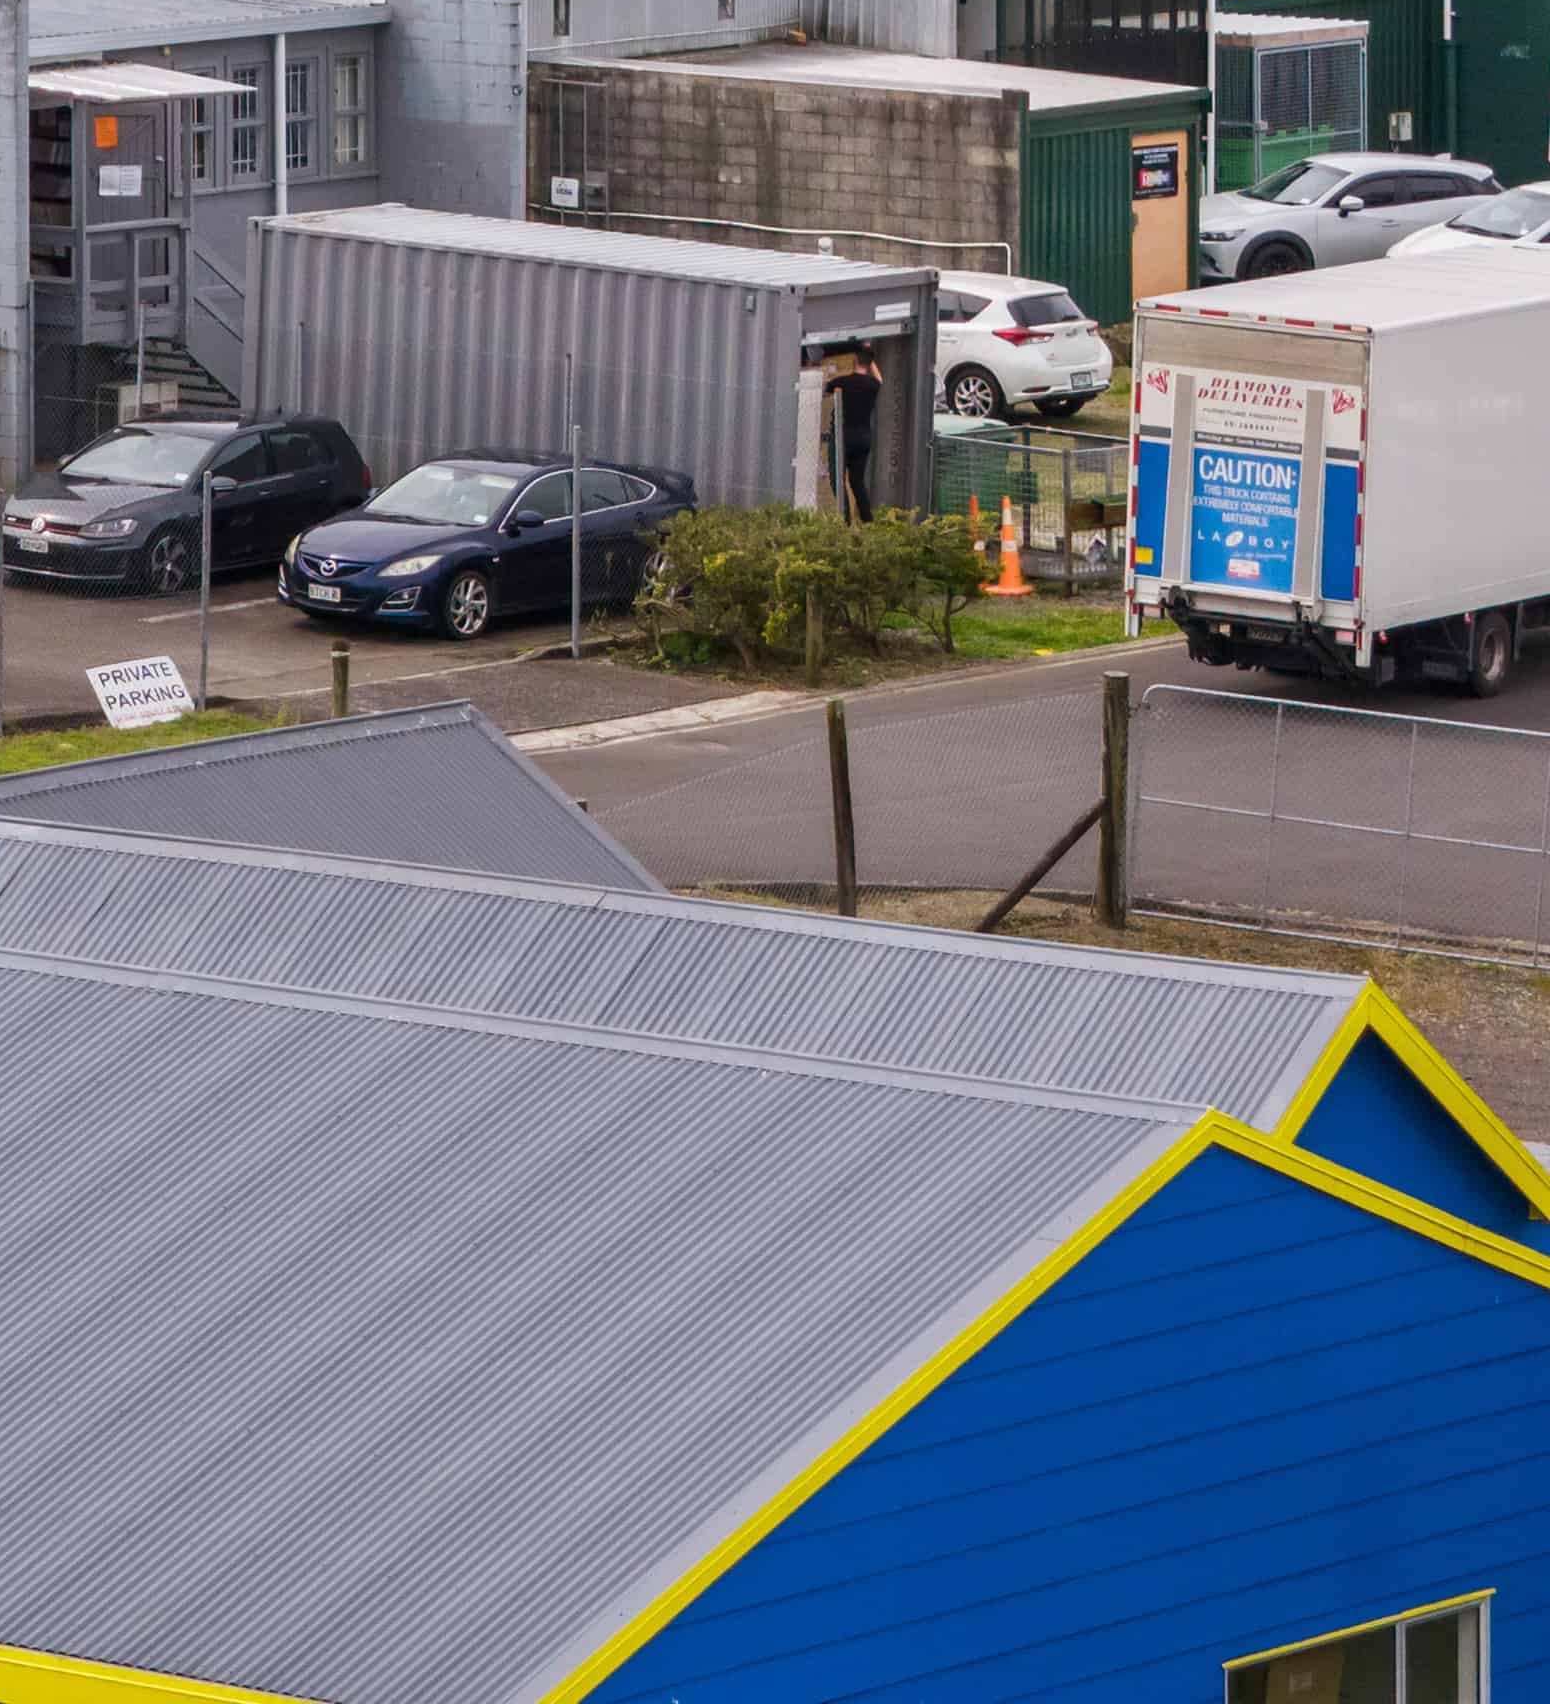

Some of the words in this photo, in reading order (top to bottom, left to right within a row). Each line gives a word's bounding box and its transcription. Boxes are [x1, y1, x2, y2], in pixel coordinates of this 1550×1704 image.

[1197, 387, 1303, 409] DELIVERIES
[1211, 377, 1292, 396] DIAMOND
[1199, 454, 1297, 489] CAUTION:
[98, 662, 173, 689] PRIVATE
[106, 684, 186, 710] PARKING
